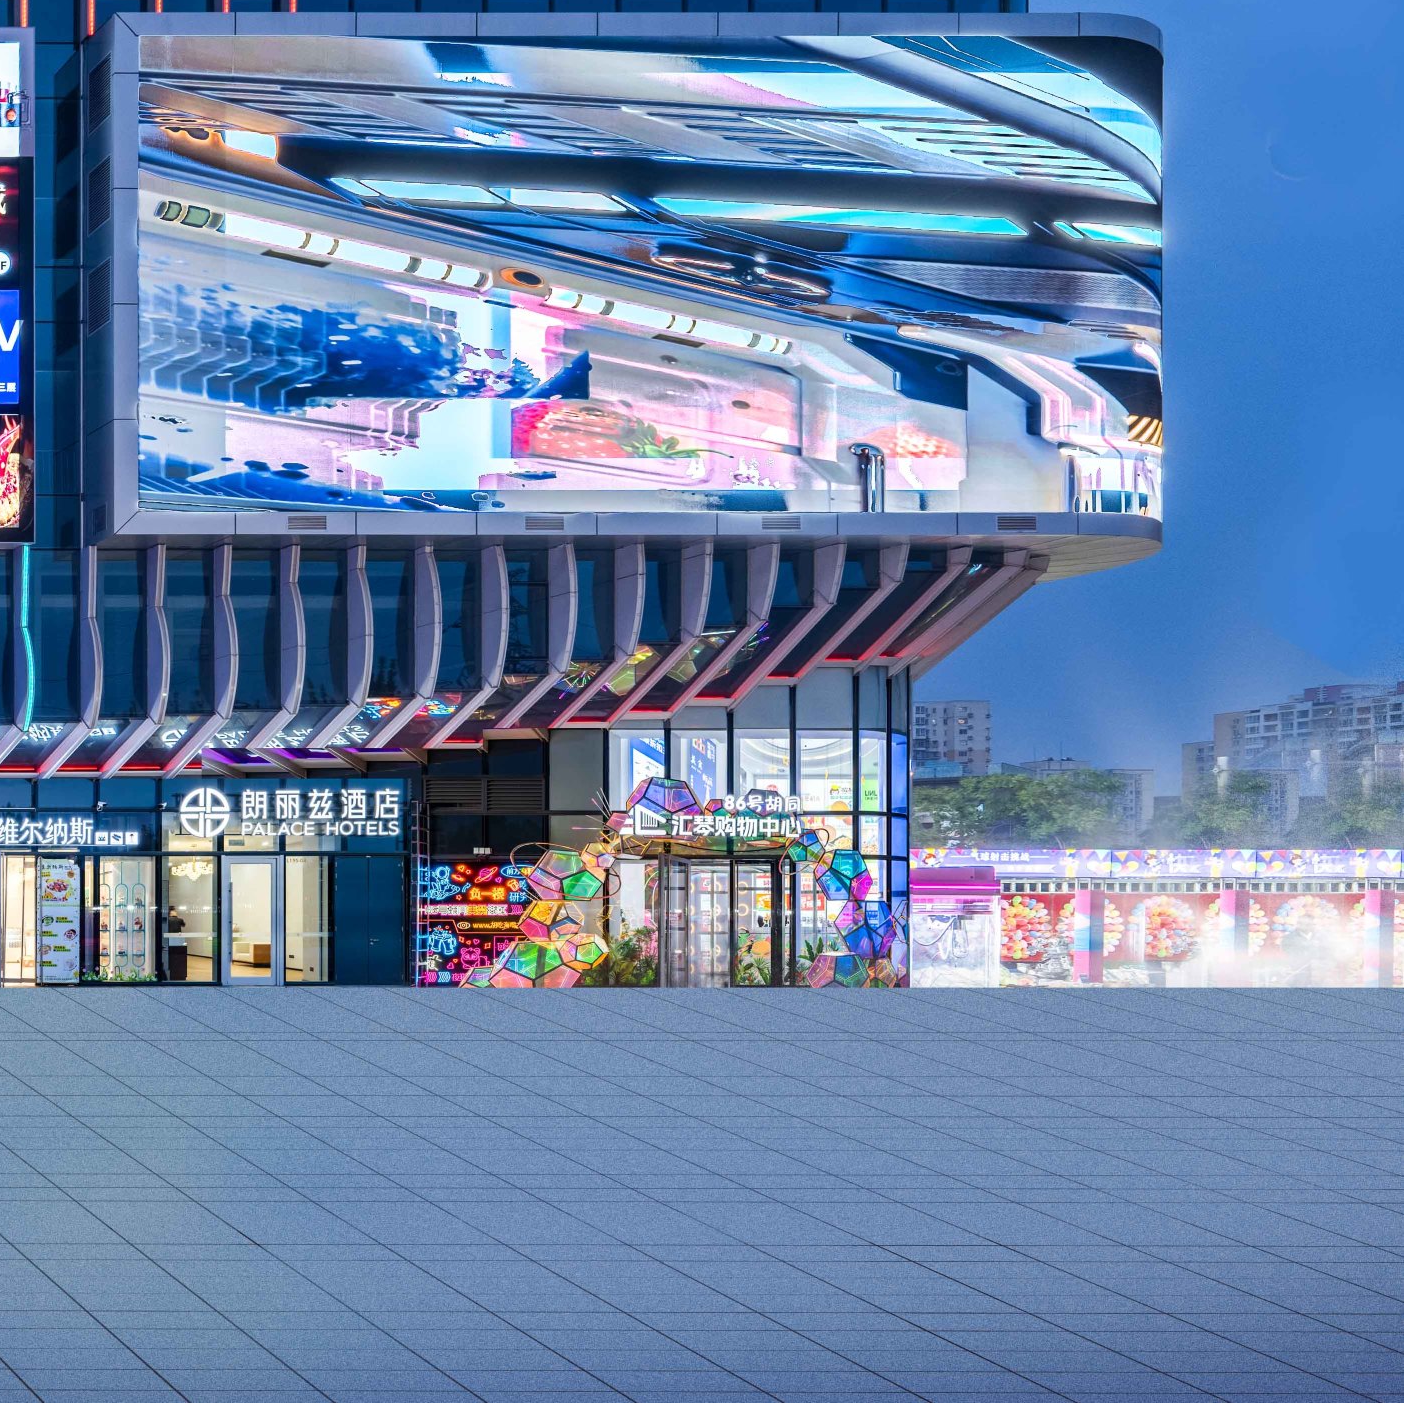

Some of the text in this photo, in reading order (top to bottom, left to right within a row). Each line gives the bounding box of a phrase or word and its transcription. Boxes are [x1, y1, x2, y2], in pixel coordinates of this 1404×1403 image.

[242, 789, 400, 820] 朗丽兹酒店
[724, 795, 802, 812] 86号胡同
[242, 821, 400, 836] PALACE HOTELS
[671, 815, 802, 838] 汇琴购物中心
